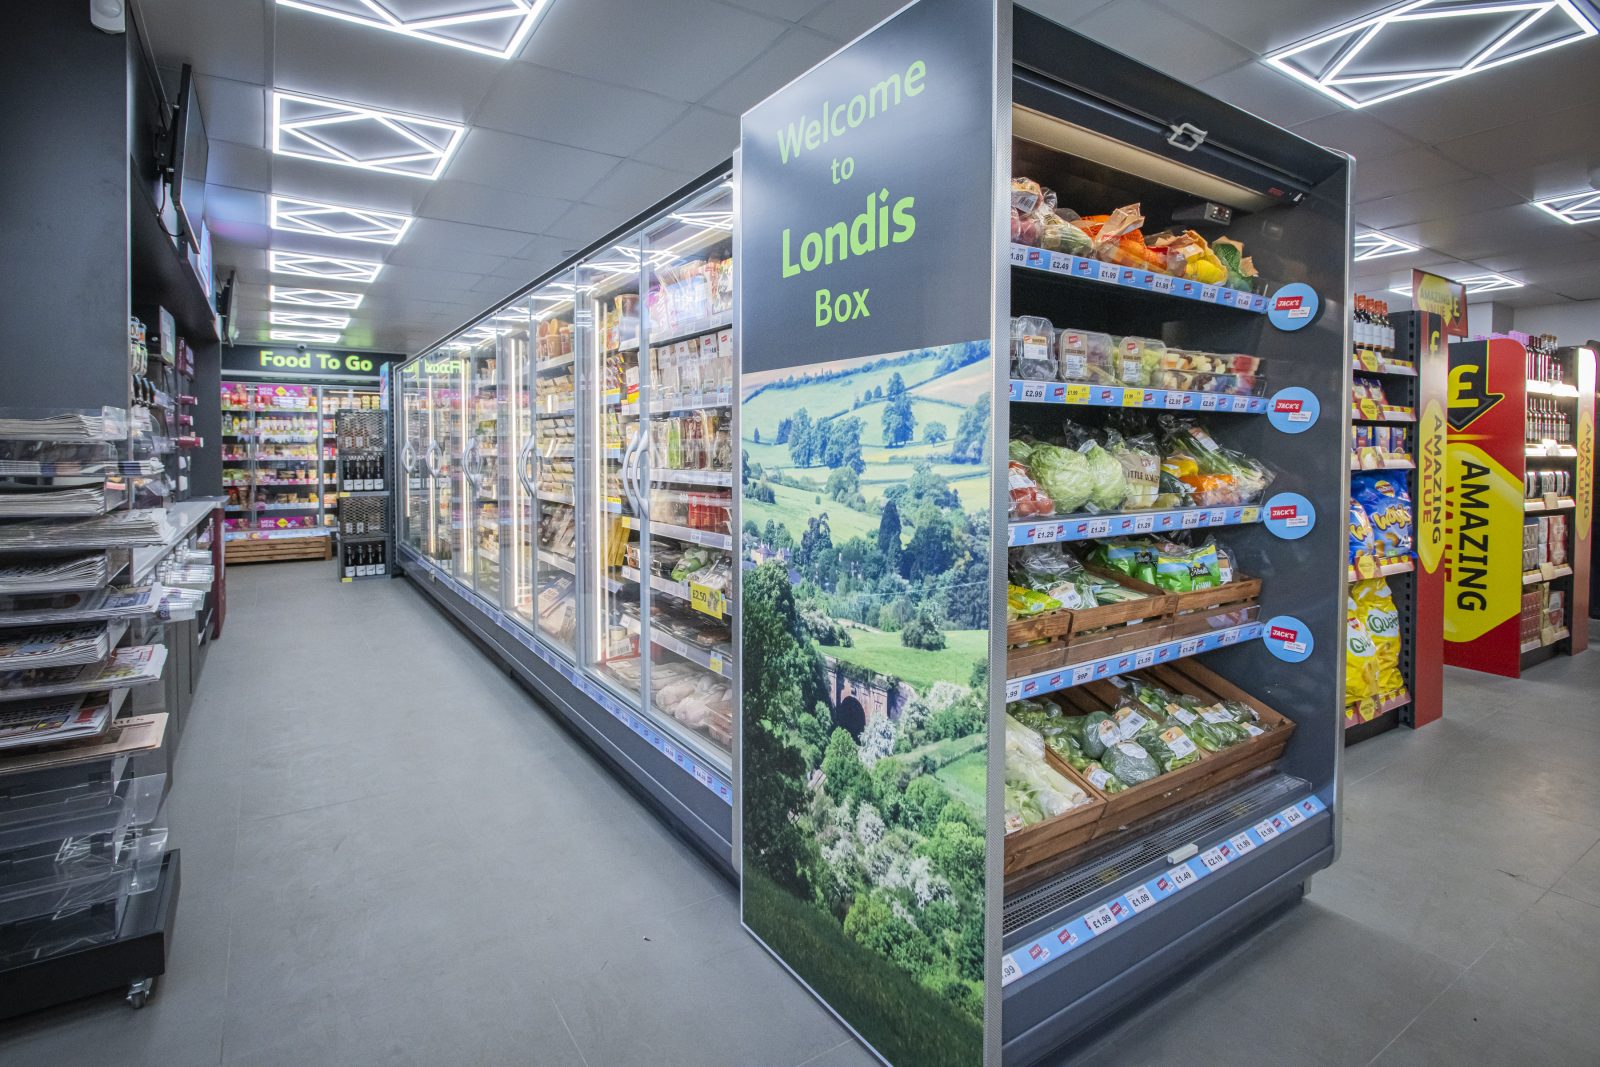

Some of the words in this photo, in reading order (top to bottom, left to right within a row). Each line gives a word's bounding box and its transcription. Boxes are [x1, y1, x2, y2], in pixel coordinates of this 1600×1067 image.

[776, 60, 926, 165] Welcome
[831, 156, 855, 185] to
[782, 188, 916, 278] Londis
[1010, 252, 1024, 262] 1.89
[815, 288, 870, 328] Box
[1277, 299, 1300, 308] JACK'S
[260, 350, 311, 368] Food
[316, 353, 341, 370] To
[345, 355, 373, 372] Go
[1025, 390, 1043, 398] £2.99
[1277, 401, 1301, 410] JACK'S
[1583, 423, 1592, 518] AMAZING
[1423, 438, 1433, 524] VALUE
[1432, 414, 1442, 544] AMAZING
[1272, 508, 1295, 516] JACK'S
[1457, 459, 1491, 612] AMAZING
[1271, 629, 1295, 640] JACK'S
[1175, 871, 1192, 884] £1.49
[1132, 893, 1150, 907] £1.09
[1092, 914, 1112, 929] £1.99
[1002, 965, 1016, 977] .99
